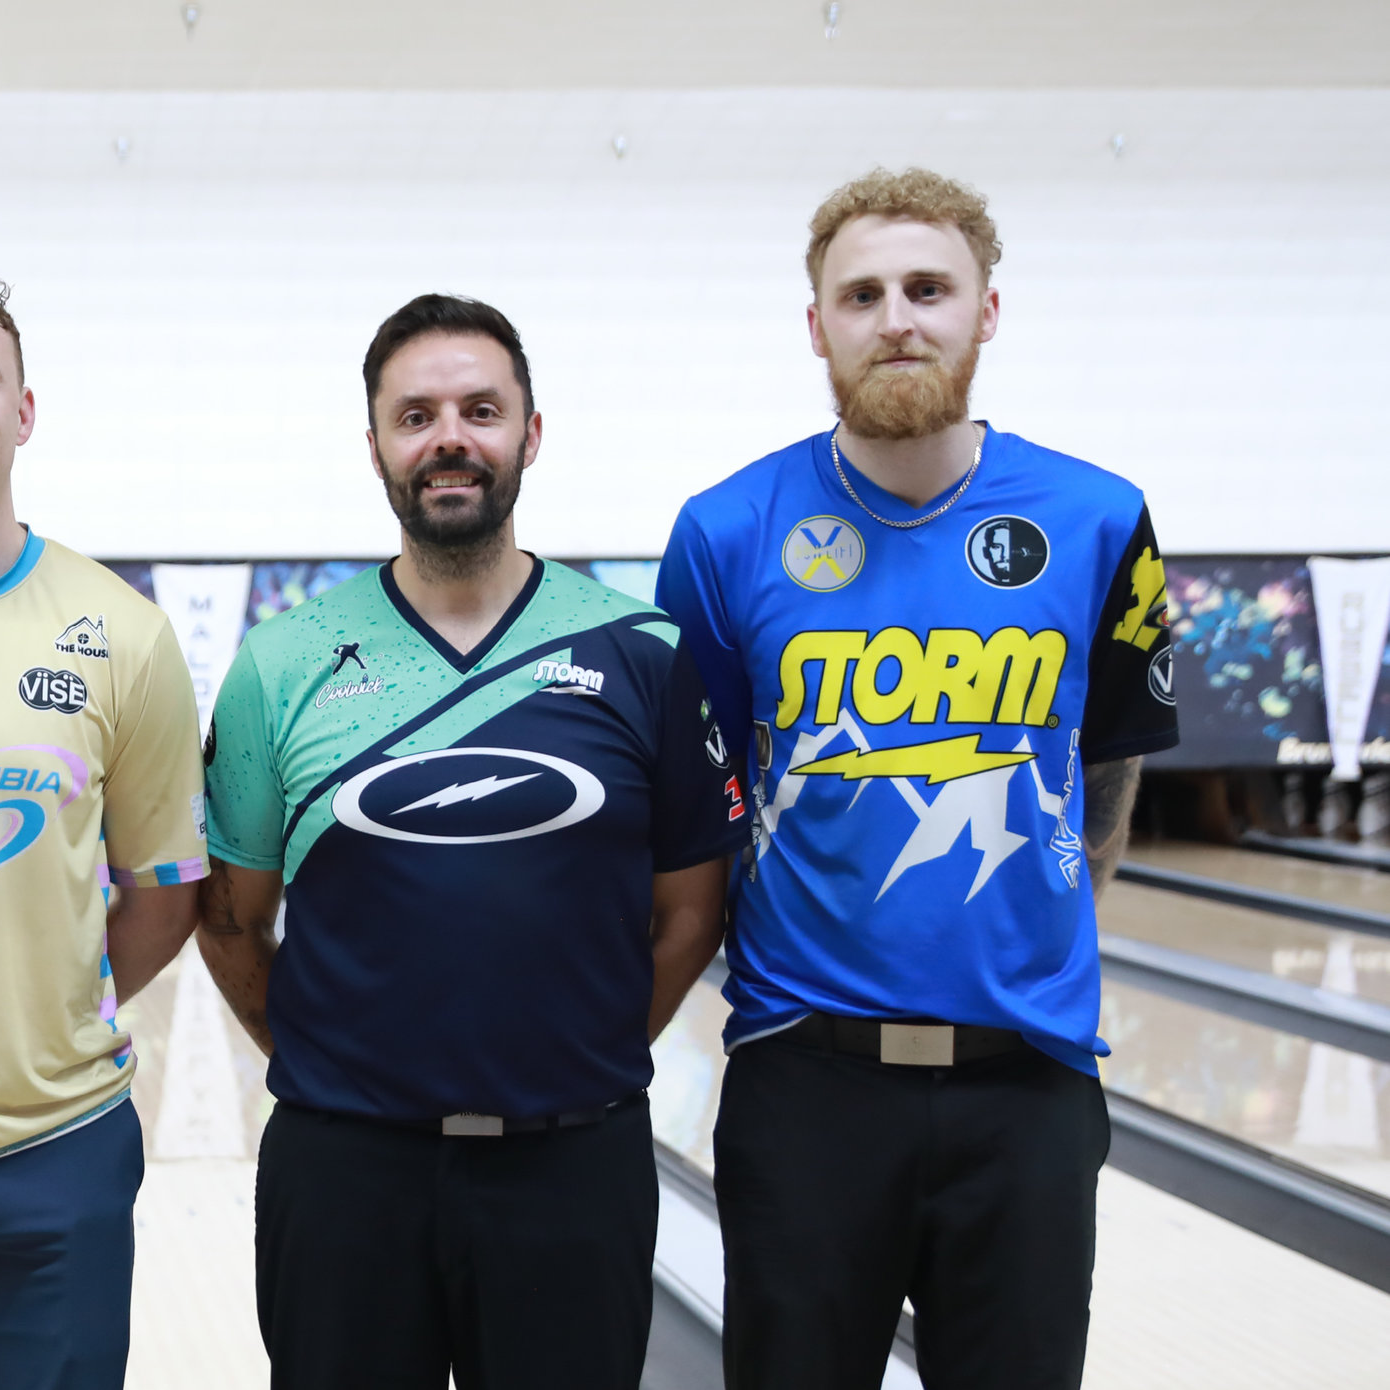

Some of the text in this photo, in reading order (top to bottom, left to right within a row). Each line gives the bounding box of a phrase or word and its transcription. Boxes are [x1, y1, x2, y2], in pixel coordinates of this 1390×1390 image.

[55, 643, 75, 653] THE
[315, 674, 385, 709] Coolwick
[532, 660, 605, 692] STORM
[775, 626, 1068, 730] STORM
